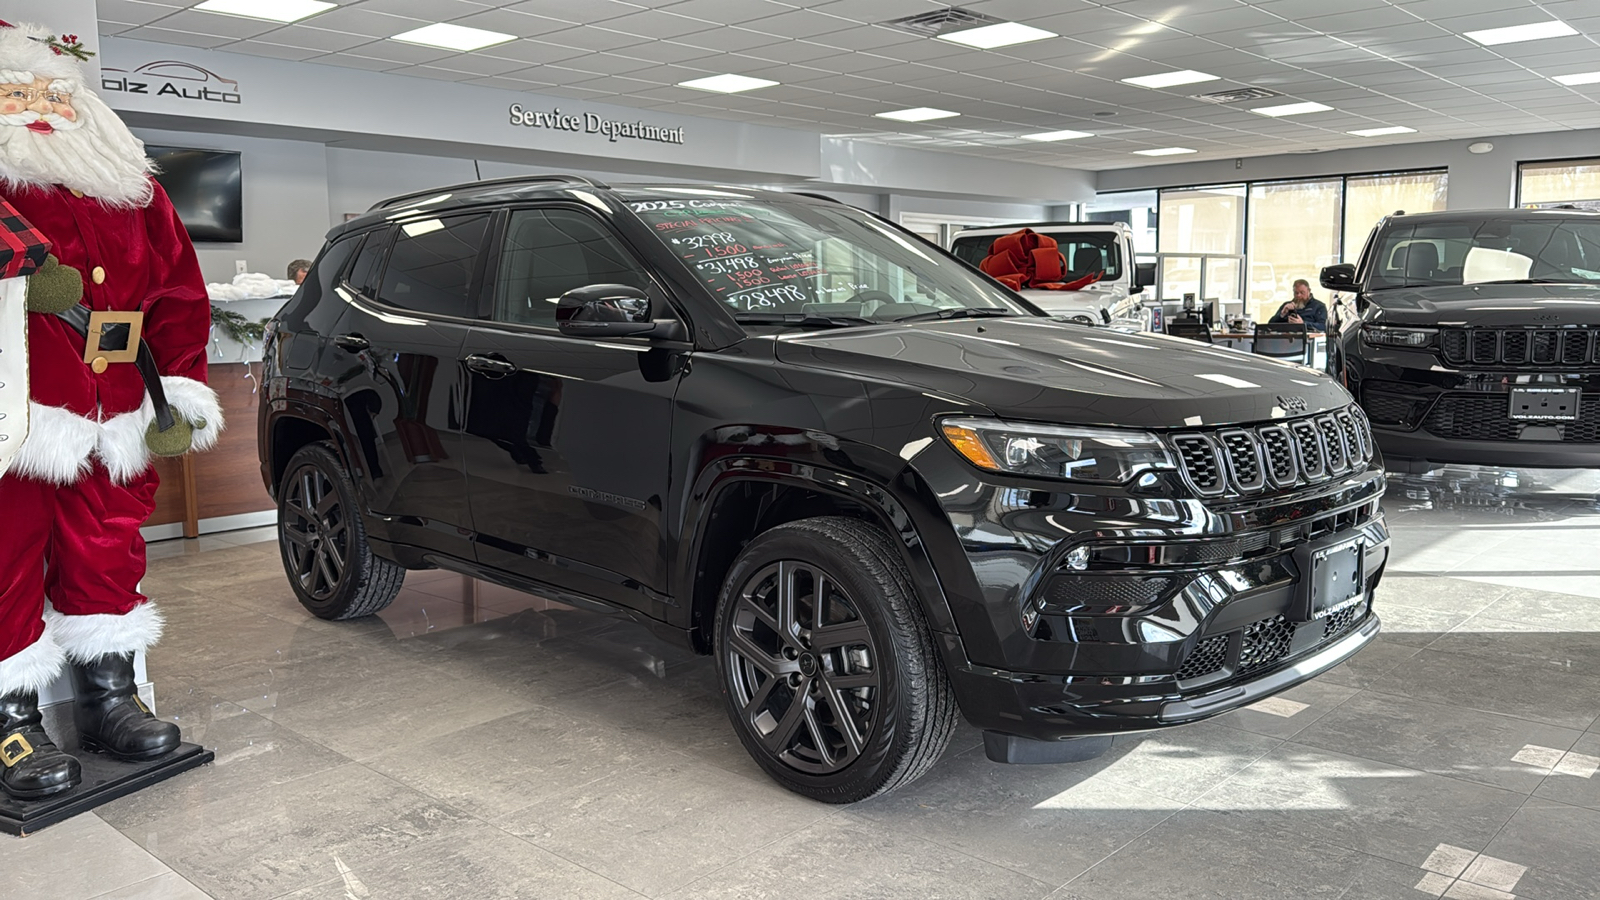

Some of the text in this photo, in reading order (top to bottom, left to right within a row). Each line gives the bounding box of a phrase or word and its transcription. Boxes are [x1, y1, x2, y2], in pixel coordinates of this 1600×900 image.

[101, 75, 241, 104] olz Auto
[509, 103, 684, 144] Service Department
[630, 200, 686, 213] 2025
[655, 219, 698, 231] SPECIAL
[1276, 395, 1308, 411] Jeep
[567, 484, 646, 511] COMPASS
